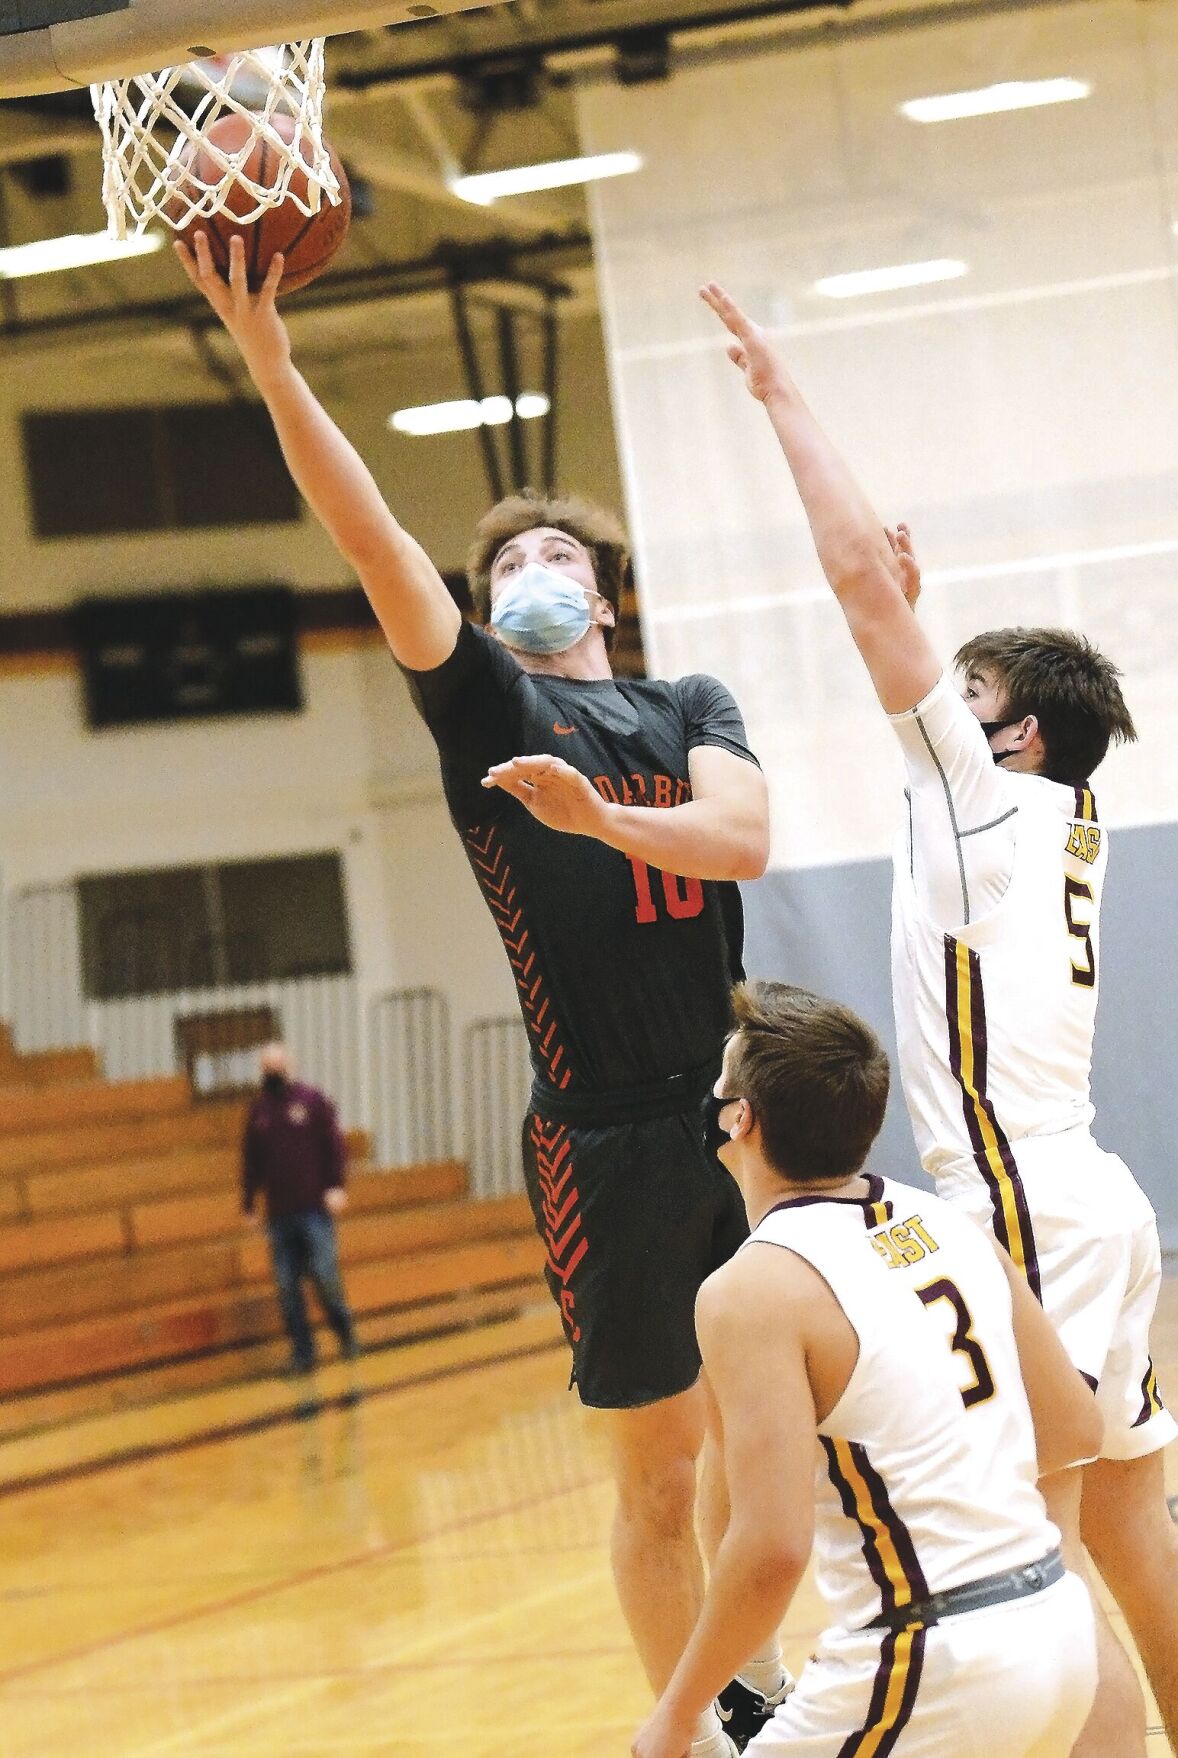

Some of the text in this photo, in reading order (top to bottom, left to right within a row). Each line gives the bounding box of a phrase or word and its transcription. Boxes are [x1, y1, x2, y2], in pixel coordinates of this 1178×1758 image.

[624, 851, 705, 924] 10
[1064, 871, 1096, 990] 5
[914, 1275, 997, 1412] 3
